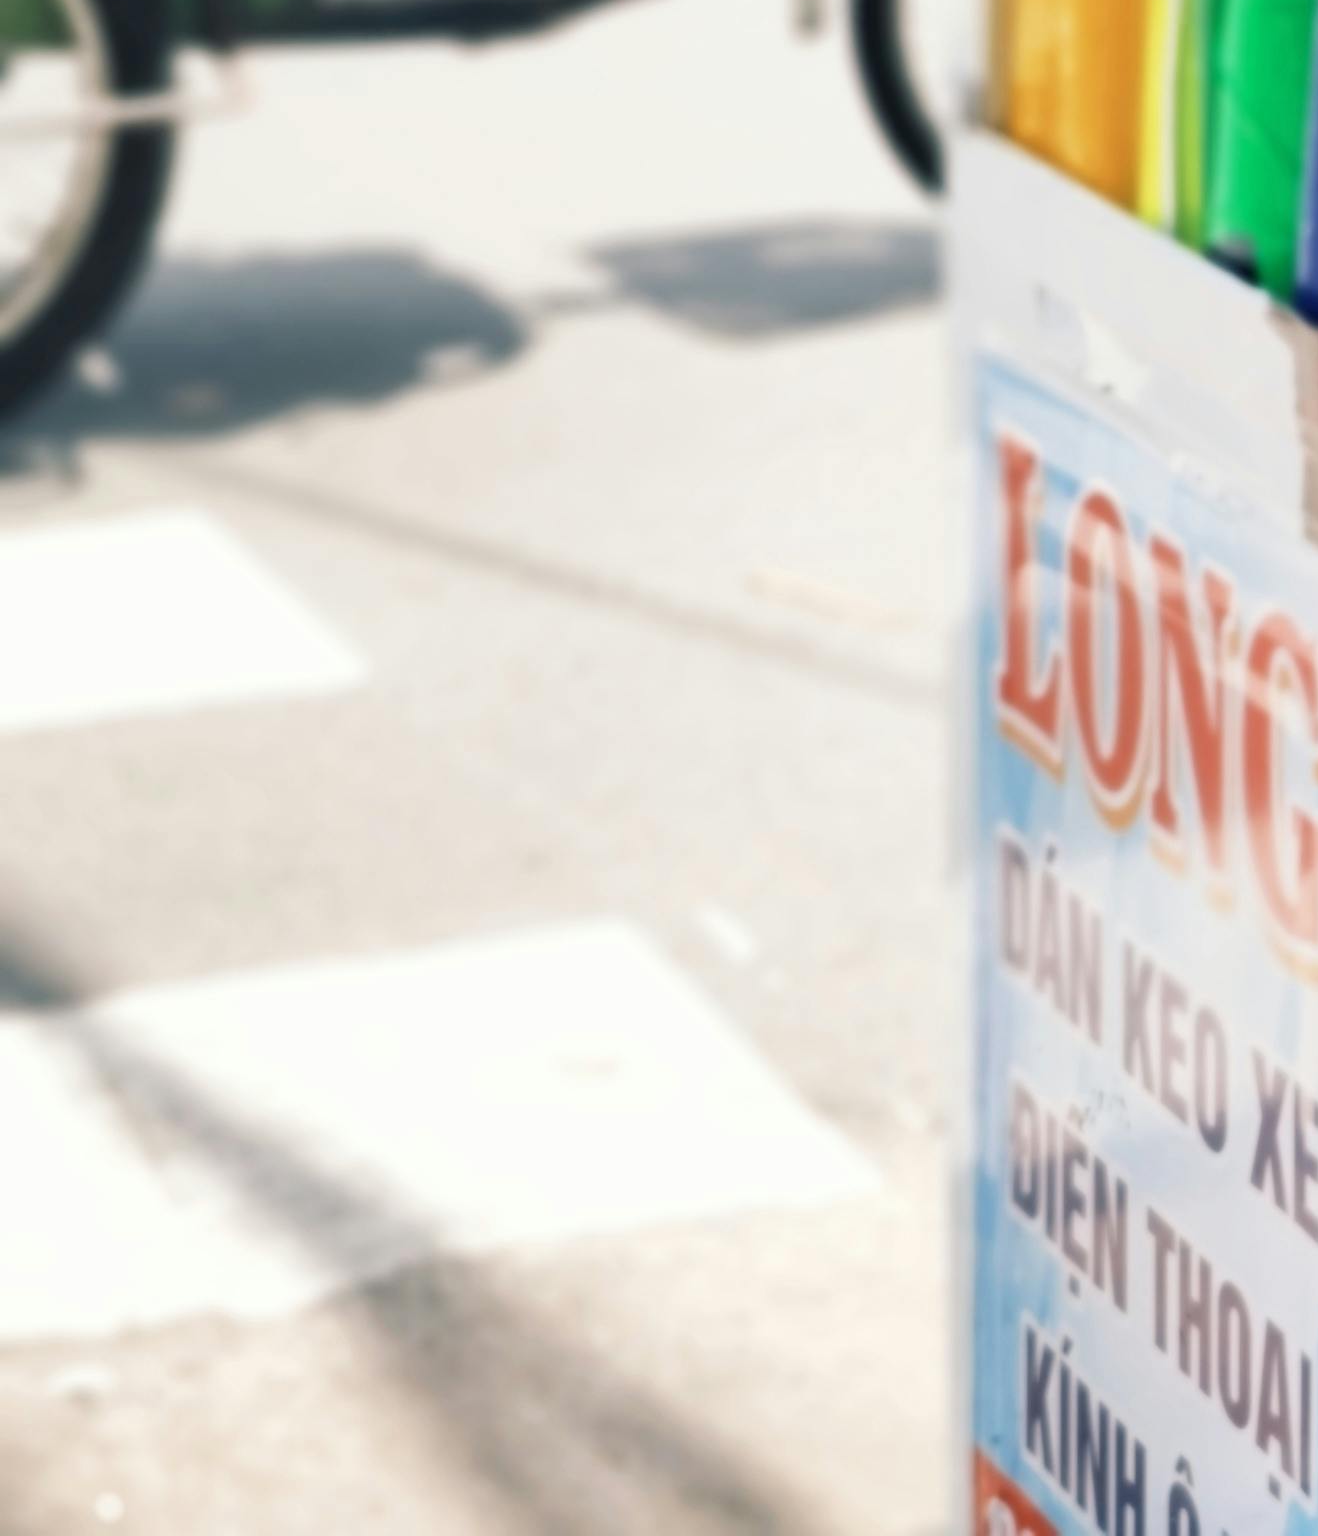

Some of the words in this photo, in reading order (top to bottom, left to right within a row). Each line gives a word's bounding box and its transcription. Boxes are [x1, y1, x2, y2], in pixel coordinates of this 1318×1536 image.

[1002, 832, 1102, 1048] DÁN
[1123, 938, 1229, 1154] KEO
[1026, 1325, 1148, 1536] KÍNH
[1147, 1206, 1312, 1500] THOẠI
